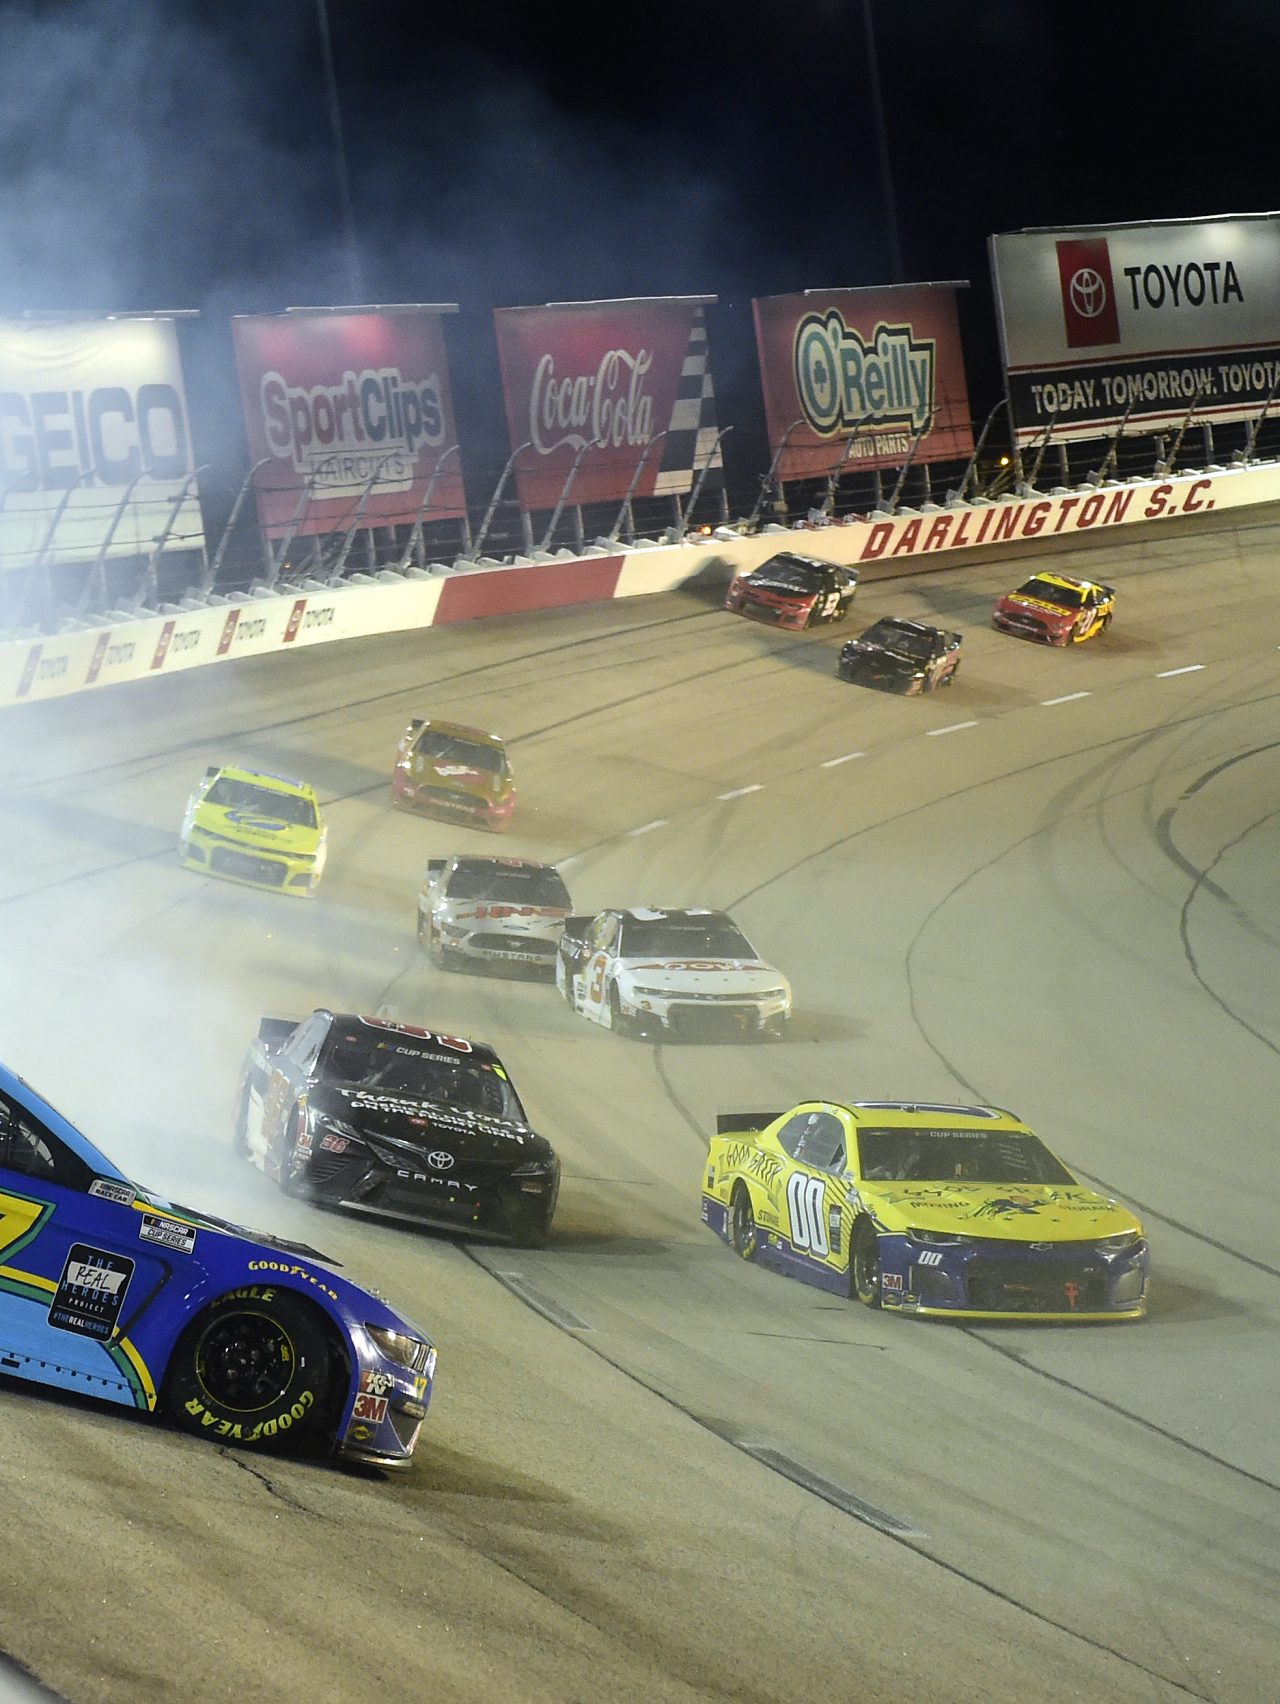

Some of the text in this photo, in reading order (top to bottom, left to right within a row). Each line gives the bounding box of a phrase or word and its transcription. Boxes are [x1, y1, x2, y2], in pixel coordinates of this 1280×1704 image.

[1124, 261, 1244, 310] TOYOTA
[799, 318, 931, 427] O'Reilly
[530, 349, 654, 455] Coca-Cola
[1032, 379, 1100, 414] TODAY.
[1102, 367, 1217, 405] TOMORROW.
[849, 433, 909, 458] AUTO PARTS
[859, 479, 1217, 561] DARLINGTON S.C.
[236, 618, 267, 640] TOYOTA
[303, 607, 335, 629] TOYOTA
[172, 628, 201, 652] TOYOTA
[396, 1047, 461, 1065] CUP SERIES
[432, 1122, 477, 1137] TOYOTA
[952, 1131, 988, 1139] SERIES
[95, 1188, 128, 1203] RACE CAR
[106, 1184, 131, 1197] NASCAR
[787, 1171, 829, 1259] 00
[148, 1228, 187, 1247] CUP SERIES
[159, 1221, 189, 1236] NASCAR
[87, 1255, 114, 1269] THE
[918, 1250, 944, 1265] 00
[77, 1265, 111, 1290] REAL
[248, 1260, 339, 1300] GOODYEAR
[883, 1274, 901, 1289] 3M
[61, 1279, 119, 1306] HEROES
[68, 1298, 105, 1313] PROJECT
[53, 1313, 109, 1334] #THEREALHEROES
[366, 1372, 395, 1395] K&N
[414, 1376, 428, 1399] 17
[184, 1391, 314, 1441] GOODYEAR
[353, 1395, 387, 1420] 3M
